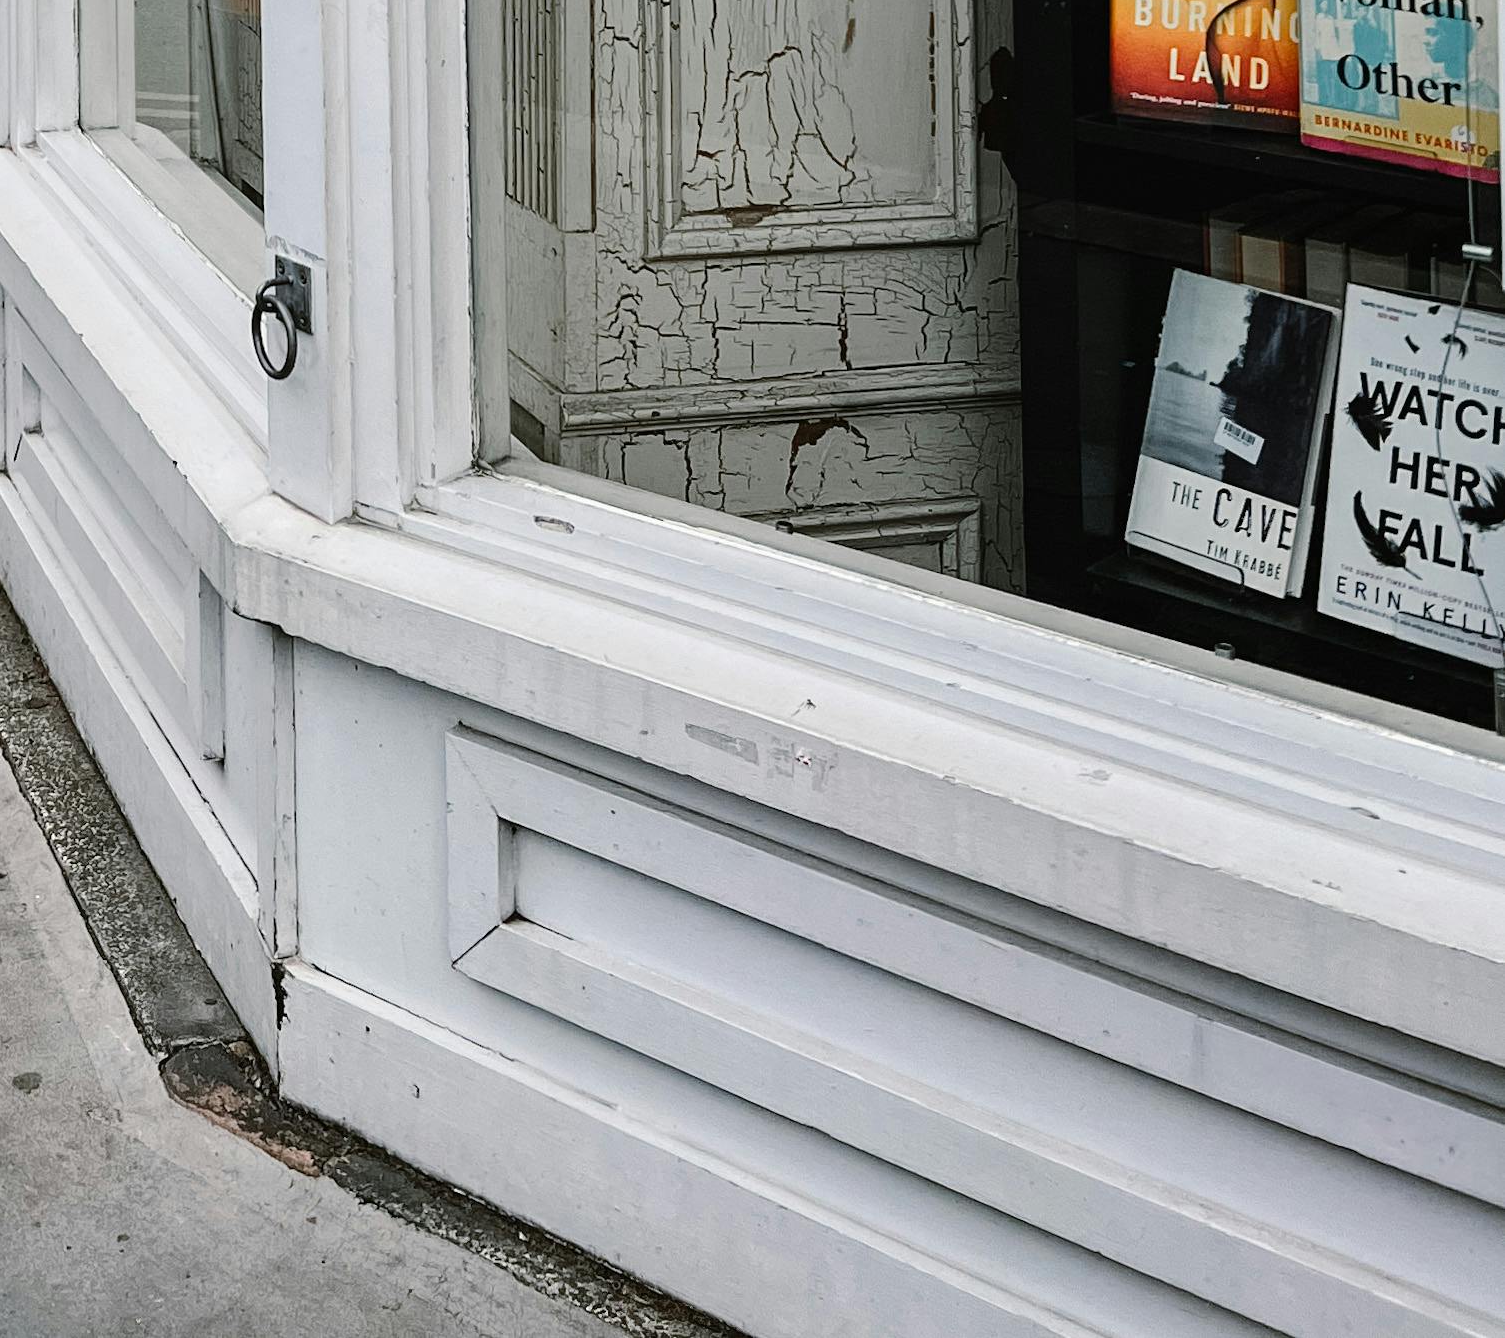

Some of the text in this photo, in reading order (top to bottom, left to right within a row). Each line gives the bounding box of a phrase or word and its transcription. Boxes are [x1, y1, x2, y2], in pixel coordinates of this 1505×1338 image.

[1169, 47, 1270, 90] LAND
[1337, 54, 1462, 107] Other
[1315, 114, 1488, 157] BERNARDINE EVARISTO
[1386, 363, 1408, 376] wrong
[1390, 446, 1481, 507] HER
[1171, 481, 1297, 551] THE CAVE
[1206, 539, 1283, 581] TIM KRABBÉ
[1377, 509, 1485, 577] FALL
[1336, 575, 1402, 610] ERIN
[1424, 601, 1505, 640] KELL
